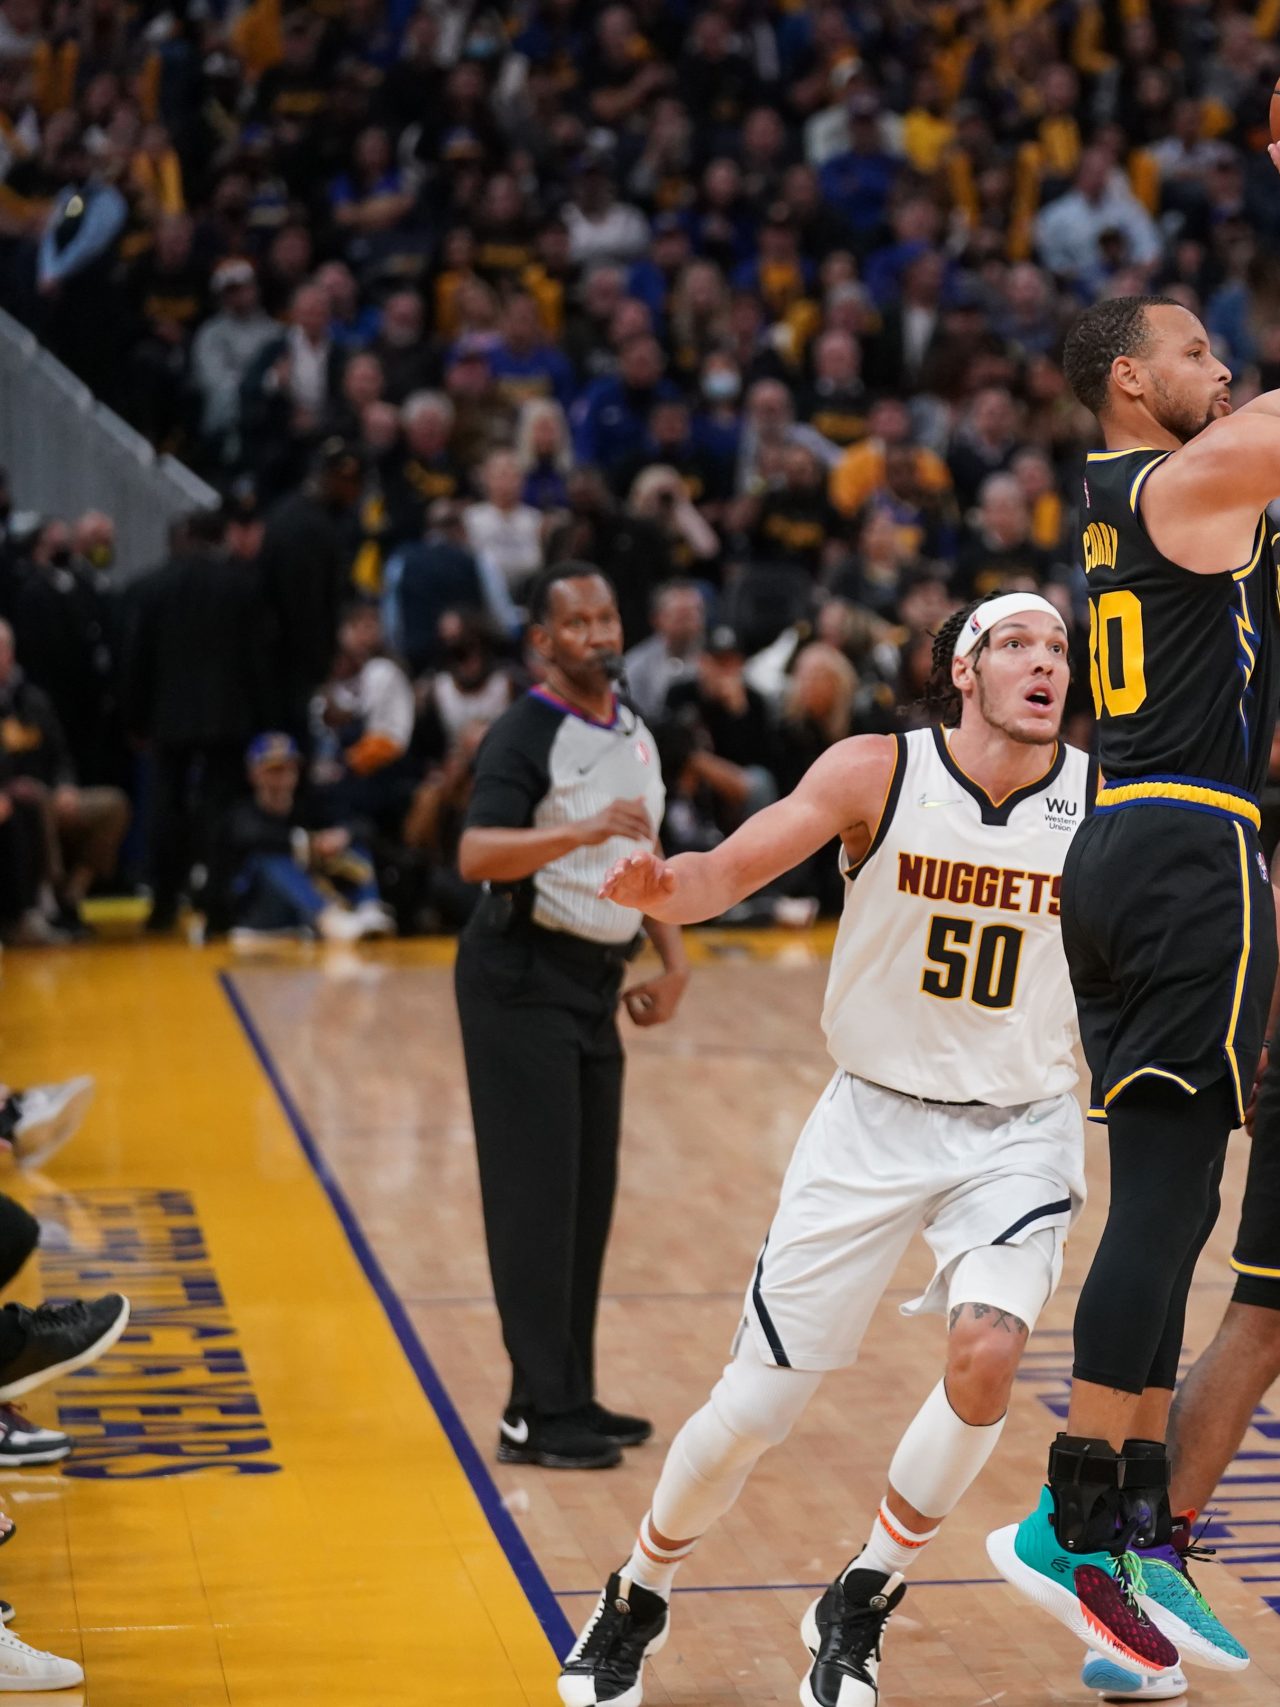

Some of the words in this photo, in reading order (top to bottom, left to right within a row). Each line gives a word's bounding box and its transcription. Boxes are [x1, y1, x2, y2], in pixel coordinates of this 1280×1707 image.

[1083, 522, 1118, 574] CURRY
[1045, 814, 1077, 826] Western
[1046, 797, 1077, 816] WU
[1049, 823, 1072, 832] Union
[920, 914, 1026, 1011] 50
[54, 1380, 282, 1479] YEARS
